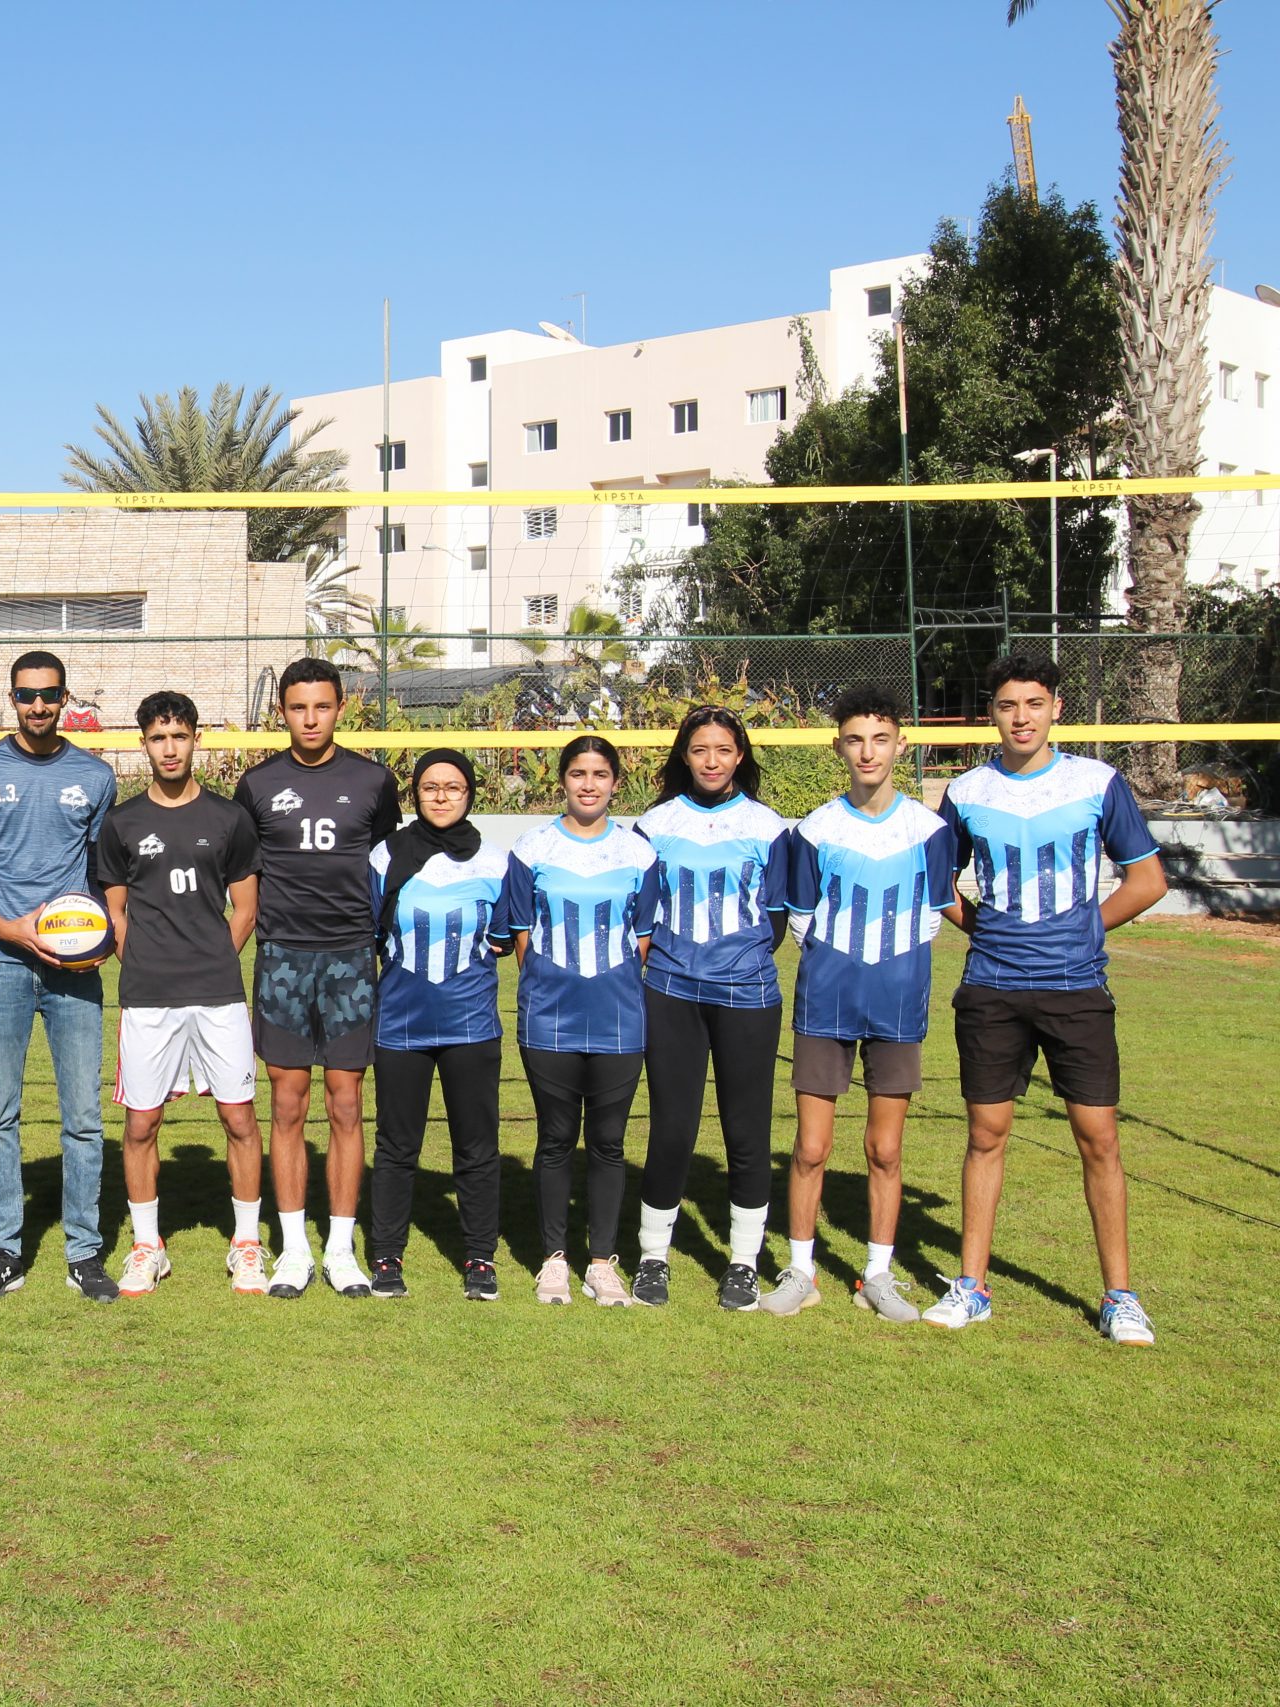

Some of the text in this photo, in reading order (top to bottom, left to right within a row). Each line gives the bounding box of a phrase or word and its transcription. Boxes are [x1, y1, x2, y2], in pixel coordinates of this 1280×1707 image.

[1071, 482, 1121, 492] KIPSTA
[115, 495, 164, 503] KIPSTA
[593, 492, 643, 501] KIPSTA
[299, 818, 336, 851] 16
[169, 867, 198, 894] 01
